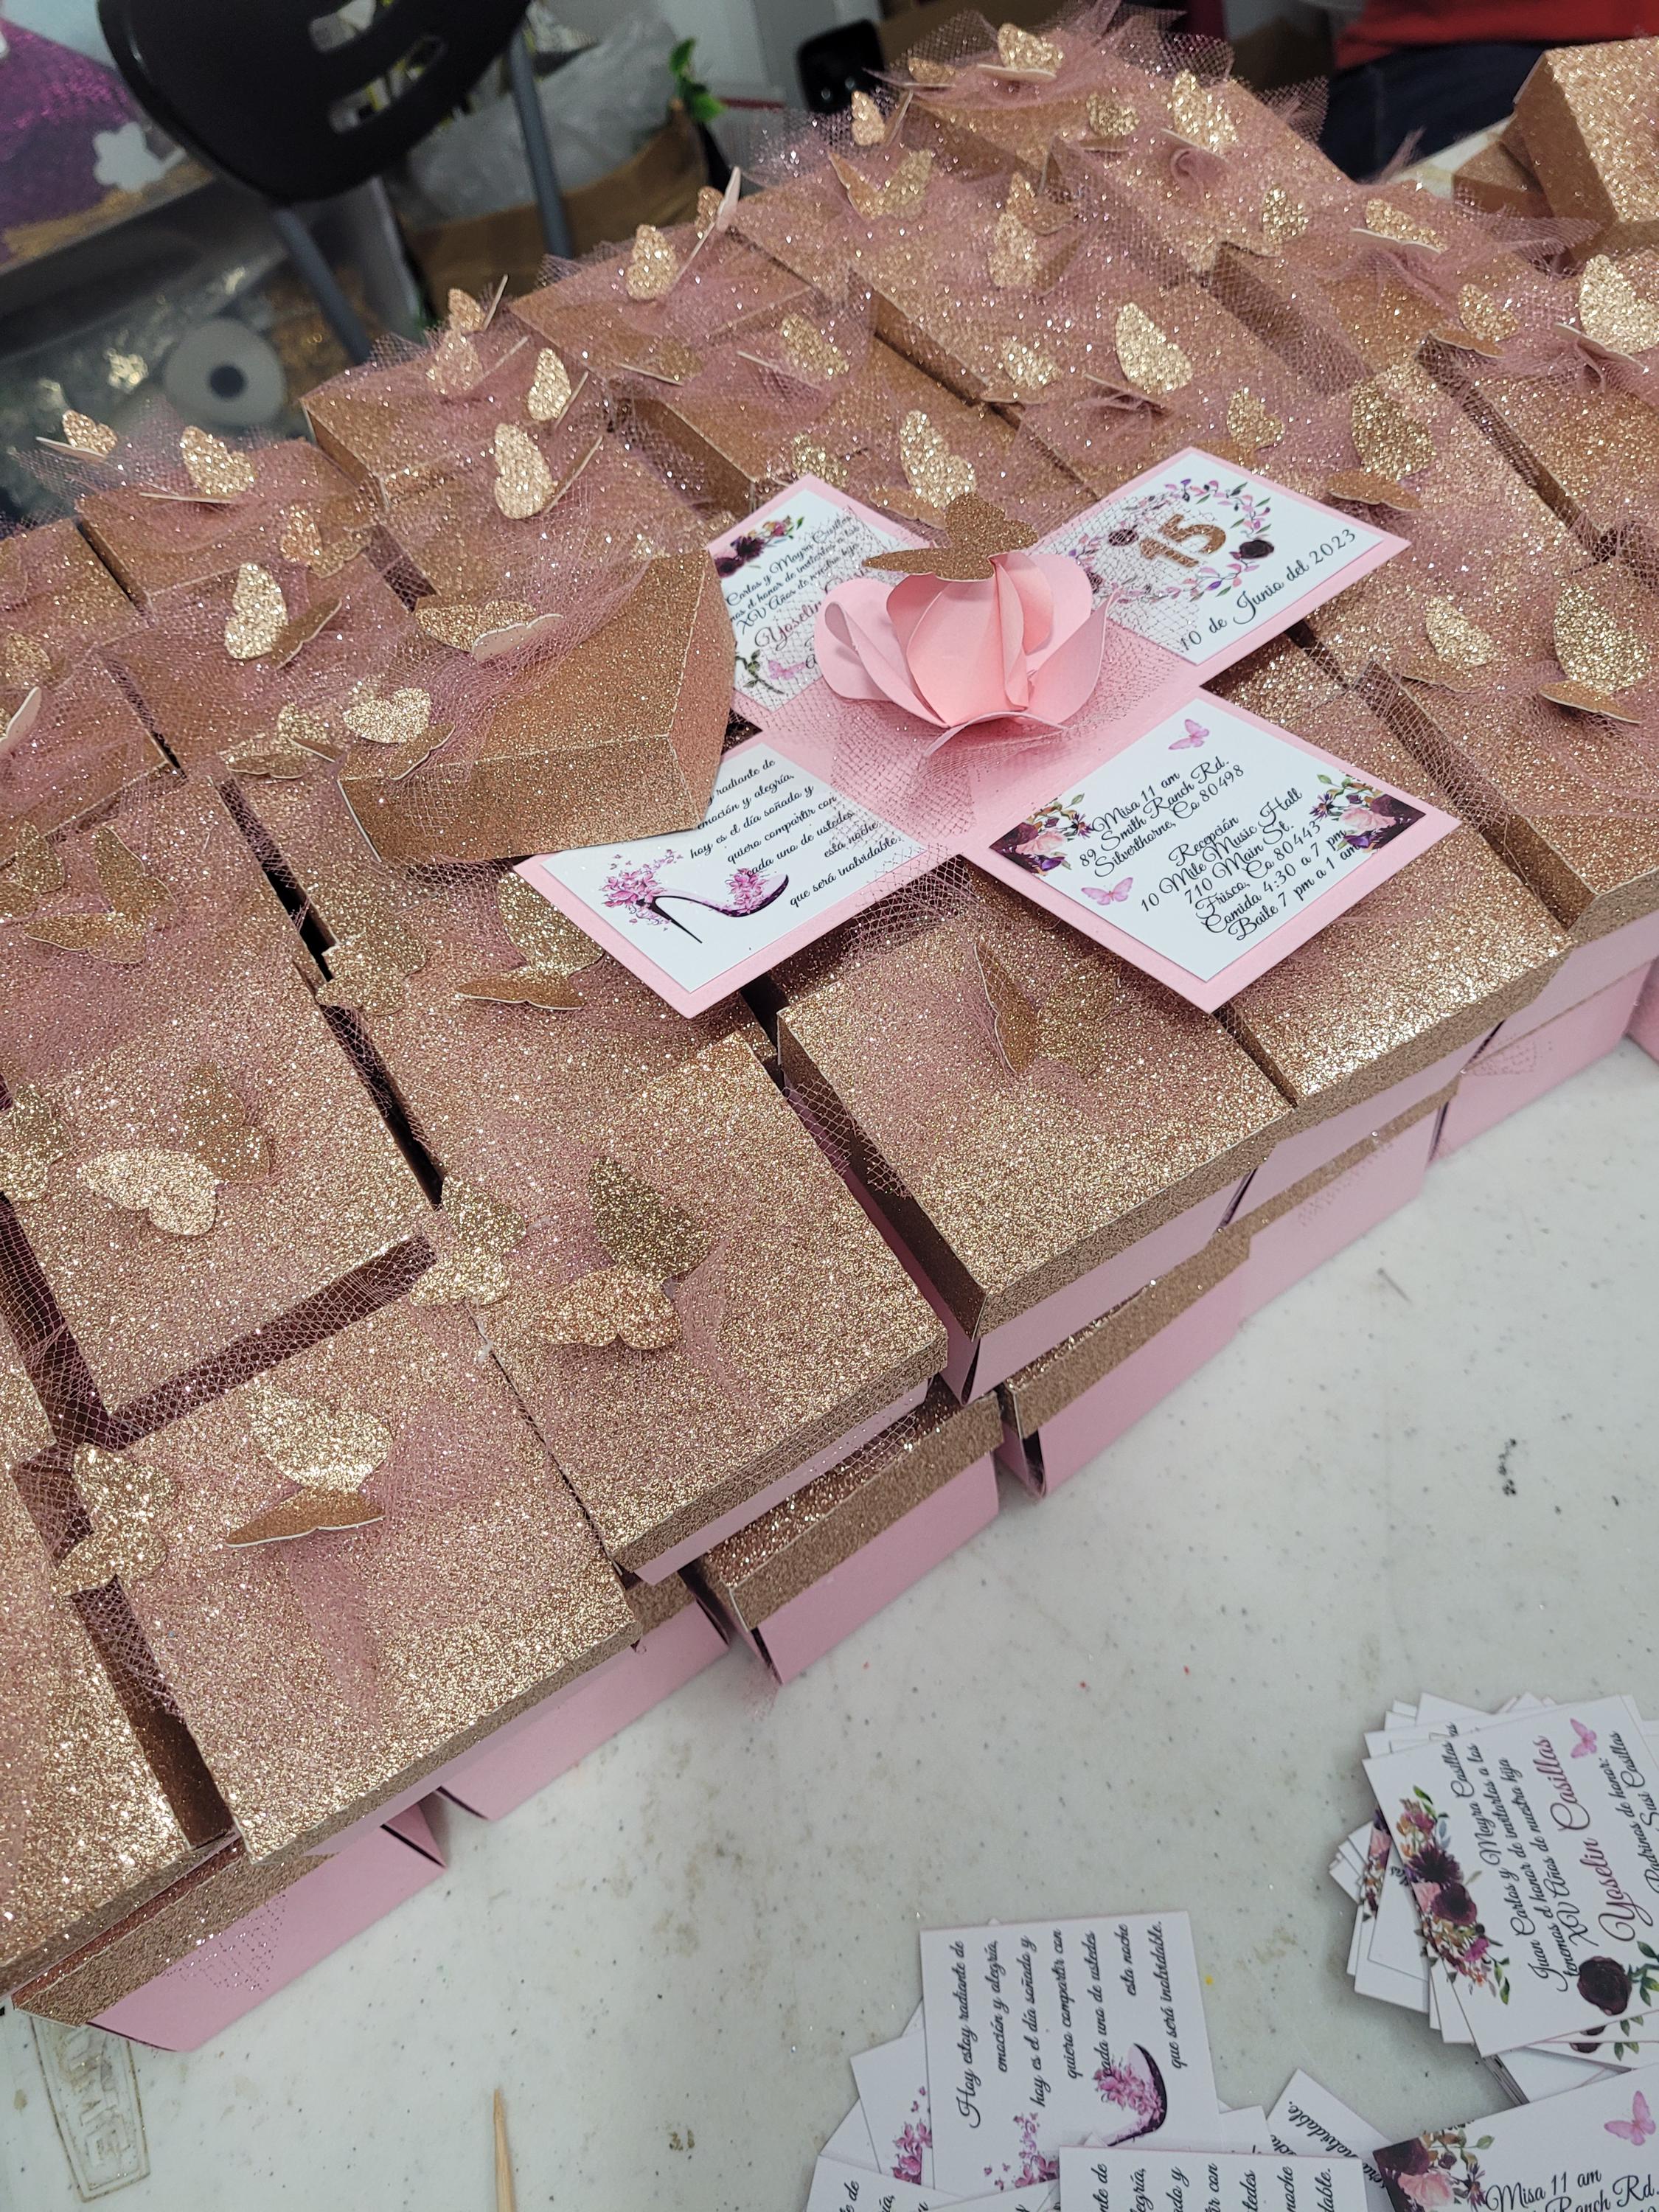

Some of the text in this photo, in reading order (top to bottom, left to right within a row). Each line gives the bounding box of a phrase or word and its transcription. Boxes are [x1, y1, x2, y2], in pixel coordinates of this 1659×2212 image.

[1139, 514, 1226, 567] 15
[726, 581, 762, 606] Carlos
[763, 574, 771, 587] y
[737, 608, 767, 635] XV
[768, 589, 796, 610] Años
[757, 582, 783, 602] honor
[785, 572, 796, 583] de
[1180, 529, 1356, 650] 10 de Junio del 2023
[716, 759, 775, 795] radiante de
[1091, 772, 1180, 832] Misa 11 am
[690, 785, 814, 859] hoy es el día soñado y
[698, 800, 740, 830] emoción
[742, 796, 751, 809] y
[727, 795, 837, 864] quiero compartir con
[1079, 756, 1230, 867] 89 Smith Ranch Rd.
[1094, 820, 1177, 877] Silverthorne,
[1169, 801, 1200, 819] Co
[1169, 815, 1239, 867] Recepción
[747, 810, 855, 877] cada uno de ustedes
[824, 841, 846, 858] esta
[1141, 787, 1303, 912] 10 Mile Music Hall
[1185, 821, 1295, 905] 710 Main St.
[1194, 820, 1321, 919] Frisco, Co 80443
[790, 889, 810, 906] que
[813, 872, 837, 892] será
[1201, 830, 1347, 933] Comida 4:30 a 7 pm
[1227, 845, 1360, 942] Baile 7 pm a 1 am
[1609, 1731, 1646, 1788] Casillas
[1532, 1735, 1654, 1942] Yoselin Casillas
[1615, 1802, 1635, 1818] de
[1441, 1740, 1568, 1992] Juan Carlos y Mayra Casillas
[1467, 1742, 1580, 1977] tenemos el honor de invitarlos a los
[1498, 1758, 1599, 1947] XV Años de nuestra hija
[1114, 1923, 1136, 1996] esta noche
[994, 1997, 1009, 2014] y
[1016, 1935, 1051, 2107] hoy es el día soñado y
[1051, 1928, 1083, 2079] quiero compartir con
[1081, 1930, 1113, 2079] cada uno de ustedes
[1159, 2006, 1179, 2039] será
[950, 1941, 981, 2129] Hoy estoy radiante de
[990, 2012, 1008, 2073] emoción
[1167, 2041, 1188, 2070] que
[1287, 2101, 1359, 2158] nolvidable.
[844, 2180, 860, 2201] de
[1091, 2163, 1107, 2184] de
[1171, 2166, 1189, 2188] y
[1208, 2163, 1219, 2193] con
[1485, 2169, 1601, 2212] Misa 11 am
